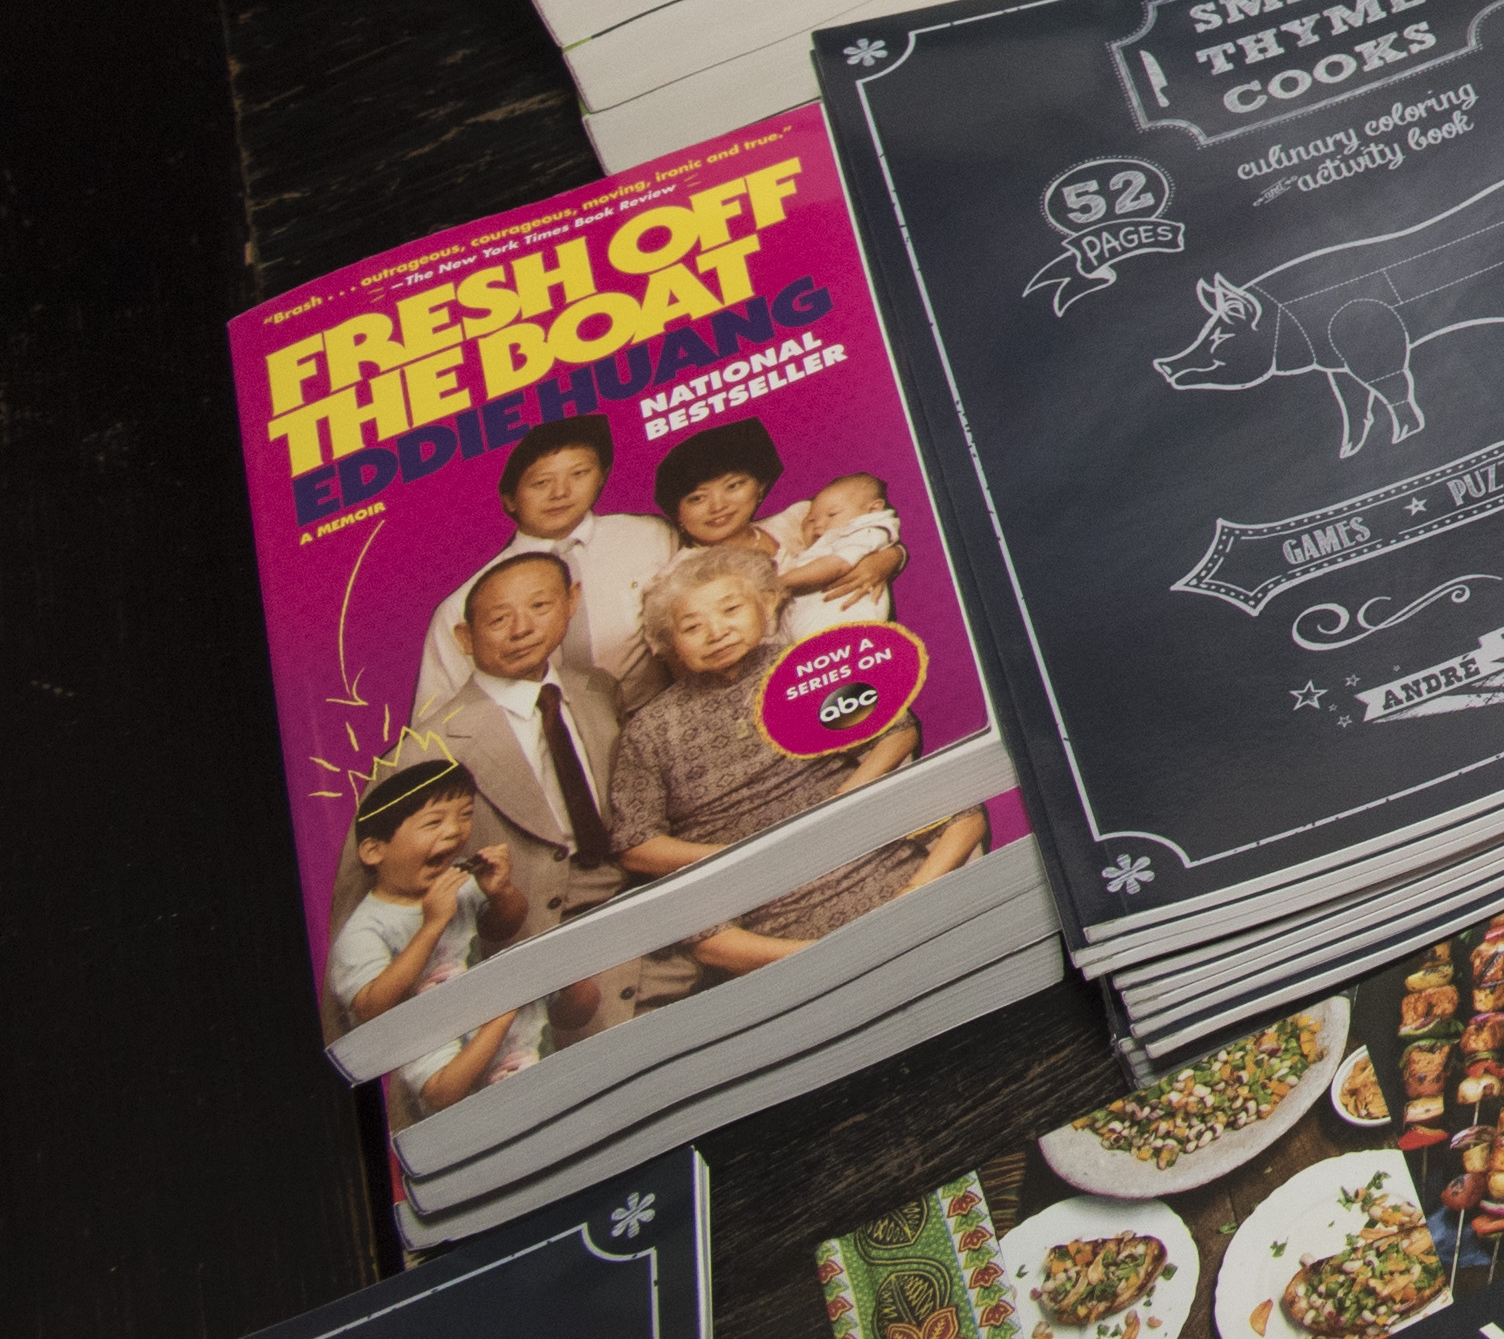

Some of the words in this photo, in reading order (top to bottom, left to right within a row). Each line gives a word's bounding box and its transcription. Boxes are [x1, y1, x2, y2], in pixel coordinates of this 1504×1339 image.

[1222, 21, 1438, 115] COOKS
[1236, 125, 1357, 183] culinary
[1364, 82, 1477, 143] coloring
[1296, 143, 1402, 197] activity
[1408, 113, 1474, 153] book
[361, 240, 466, 287] outrageous,
[471, 204, 578, 248] courageous,
[655, 159, 701, 184] ironic
[705, 148, 739, 167] and
[1062, 170, 1153, 221] 52
[1081, 222, 1173, 265] PAGES
[266, 237, 597, 415] FRESH
[608, 158, 801, 274] OFF
[268, 361, 470, 477] THE
[478, 234, 761, 400] BOAT
[640, 332, 823, 418] NATIONAL
[645, 344, 847, 441] BESTSELLER
[292, 404, 529, 527] EDDIE
[538, 276, 833, 419] HUANG
[1283, 516, 1371, 565] GAMES
[787, 666, 851, 700] SERIES
[858, 649, 892, 670] ON
[797, 645, 851, 677] NOW
[859, 639, 873, 652] A
[1380, 657, 1480, 714] ANDRÉ
[820, 690, 878, 722] abc
